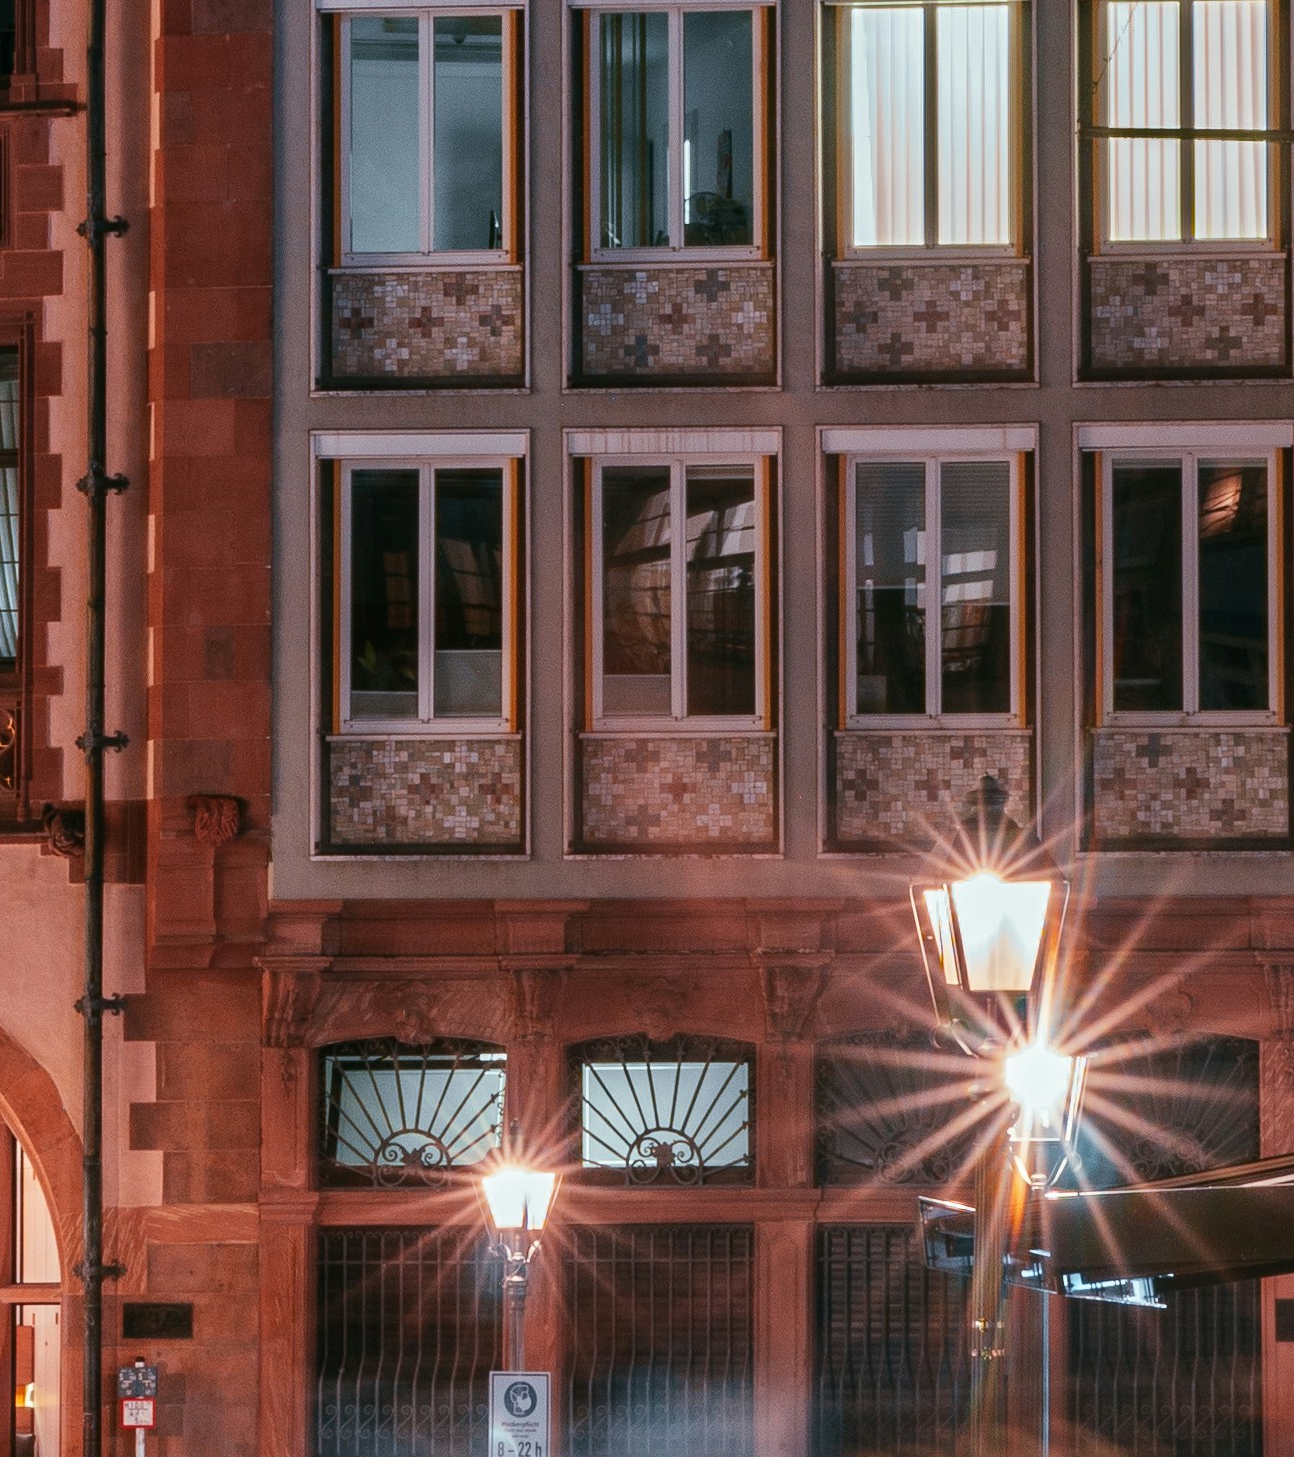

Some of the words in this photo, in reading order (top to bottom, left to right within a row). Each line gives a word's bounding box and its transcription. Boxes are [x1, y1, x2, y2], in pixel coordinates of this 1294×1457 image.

[497, 1441, 505, 1457] 8
[517, 1441, 532, 1457] 22
[535, 1441, 542, 1457] h
